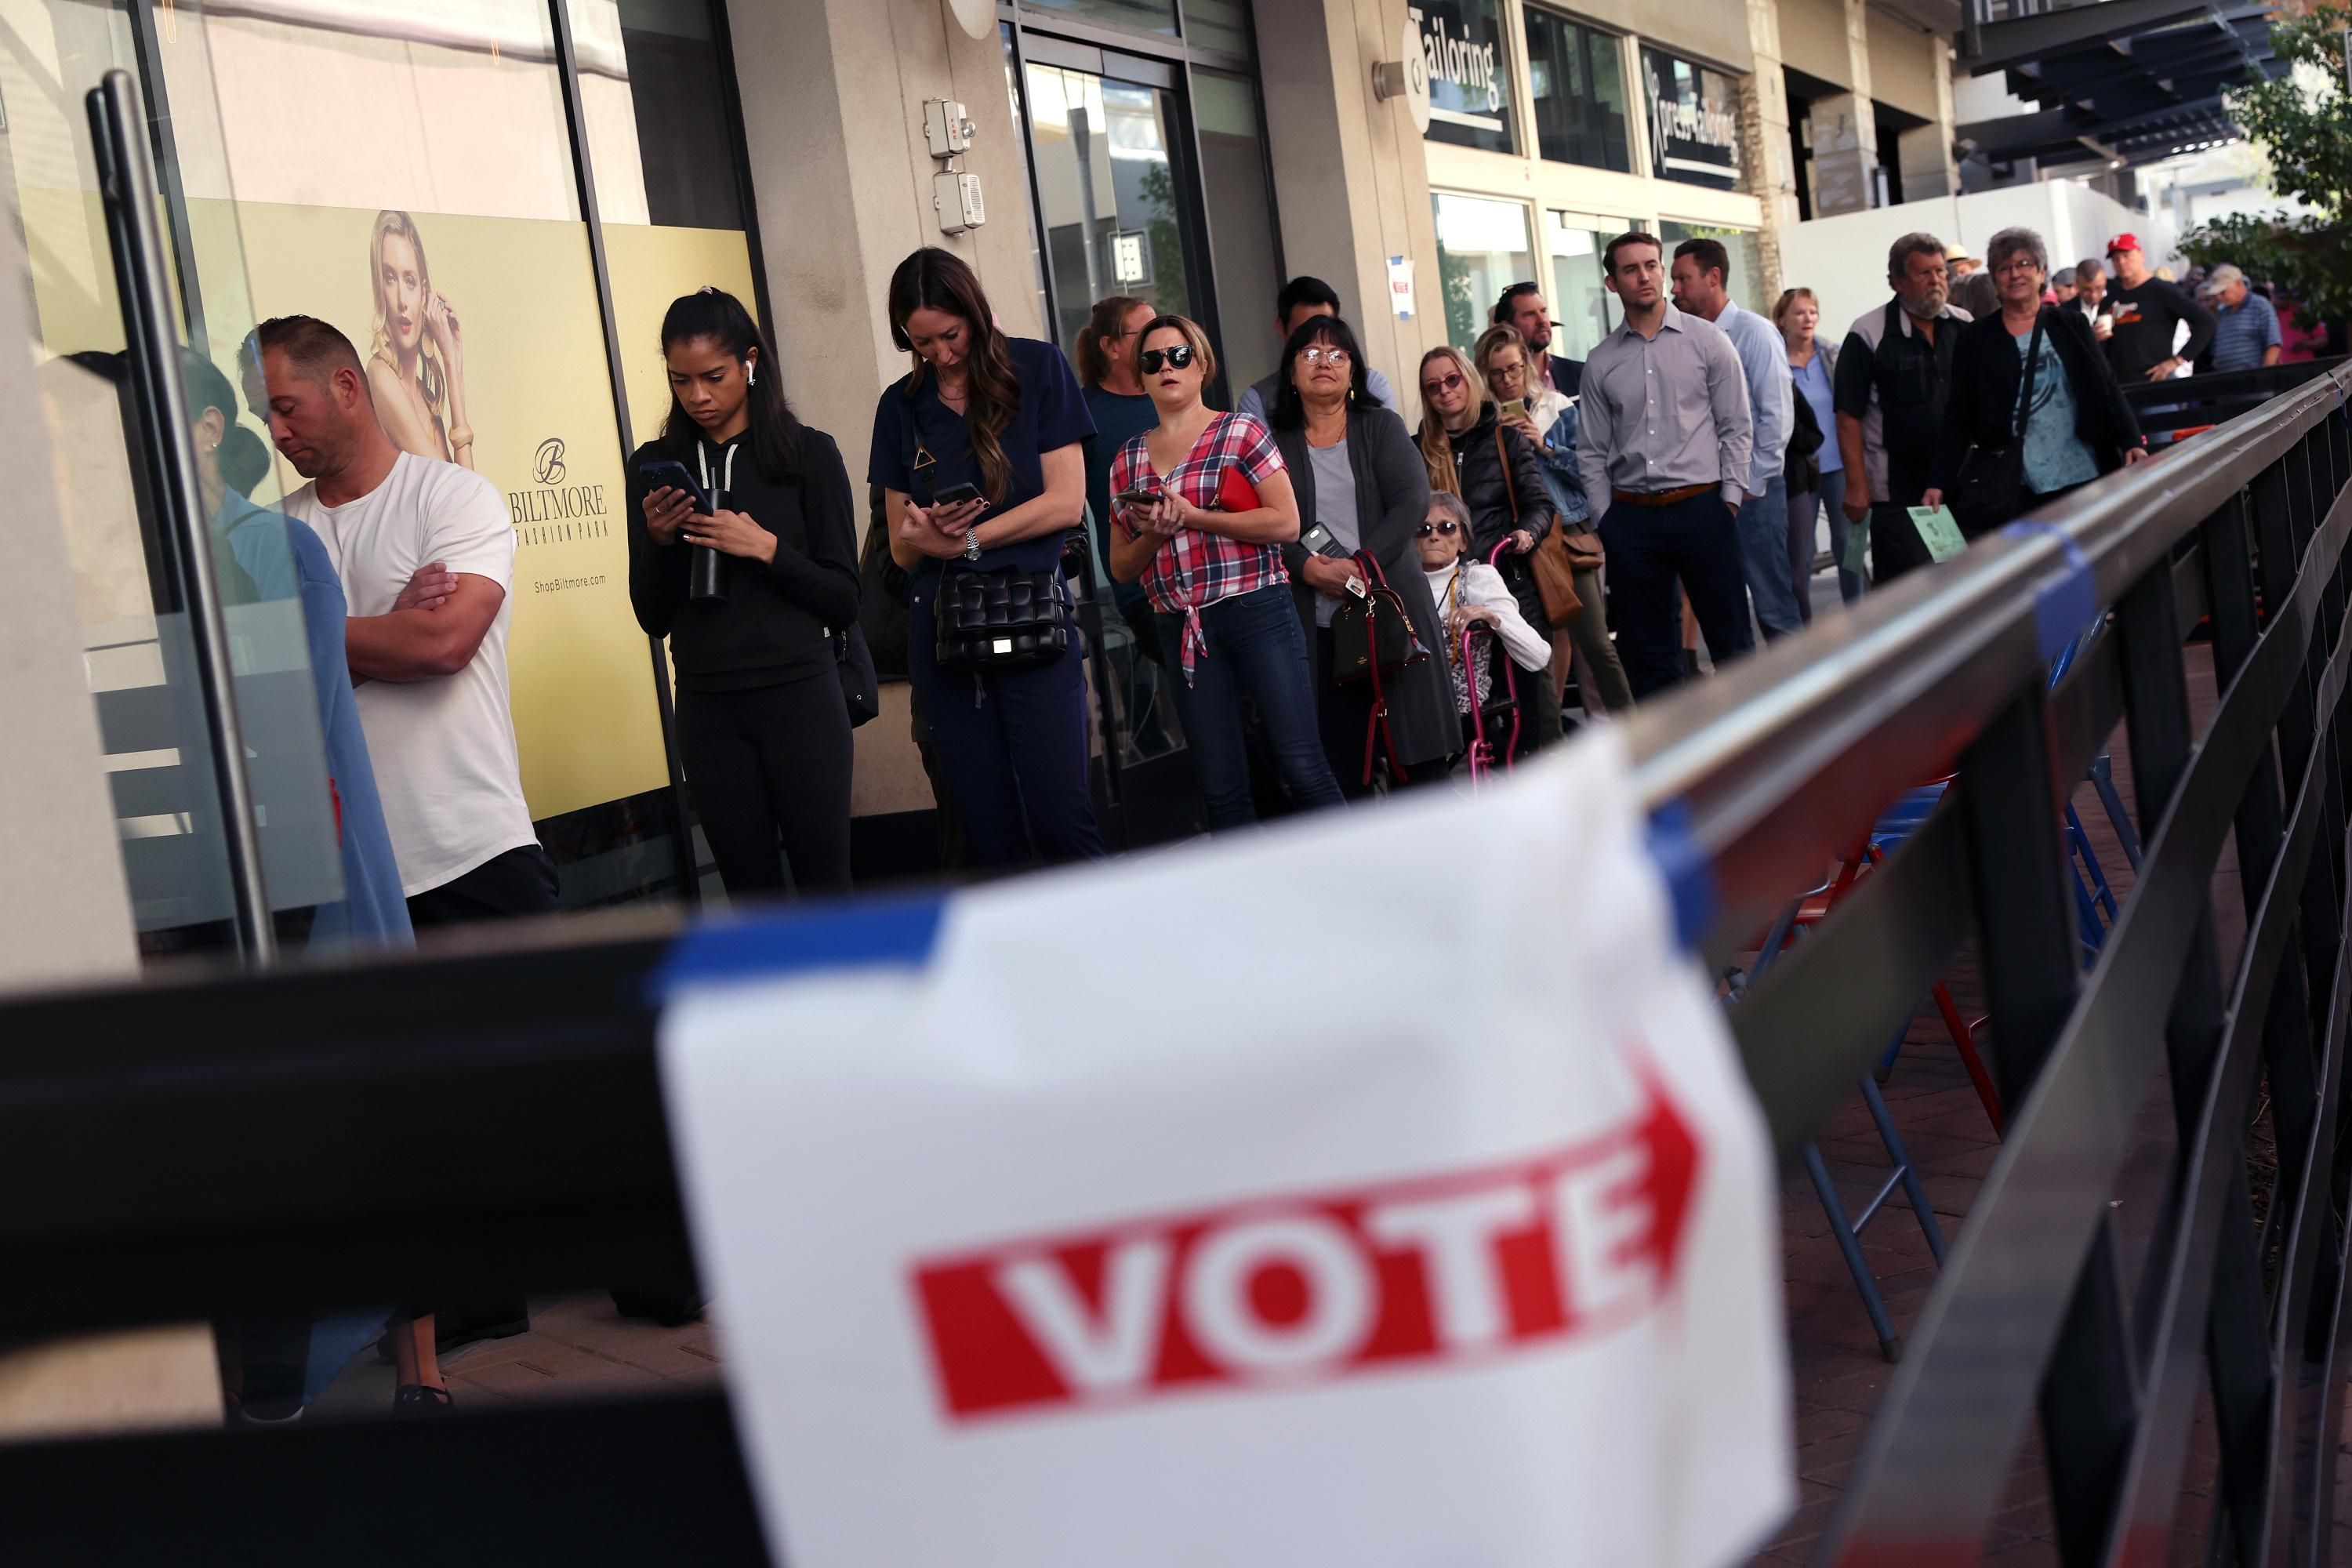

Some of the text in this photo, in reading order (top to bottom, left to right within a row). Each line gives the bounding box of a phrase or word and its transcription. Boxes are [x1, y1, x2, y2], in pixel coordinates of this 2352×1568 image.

[508, 485, 608, 524] BILTMORE
[515, 520, 608, 547] FASHION PARK
[534, 575, 606, 593] ShopBiltmore.com
[989, 1138, 1661, 1399] VOTE
